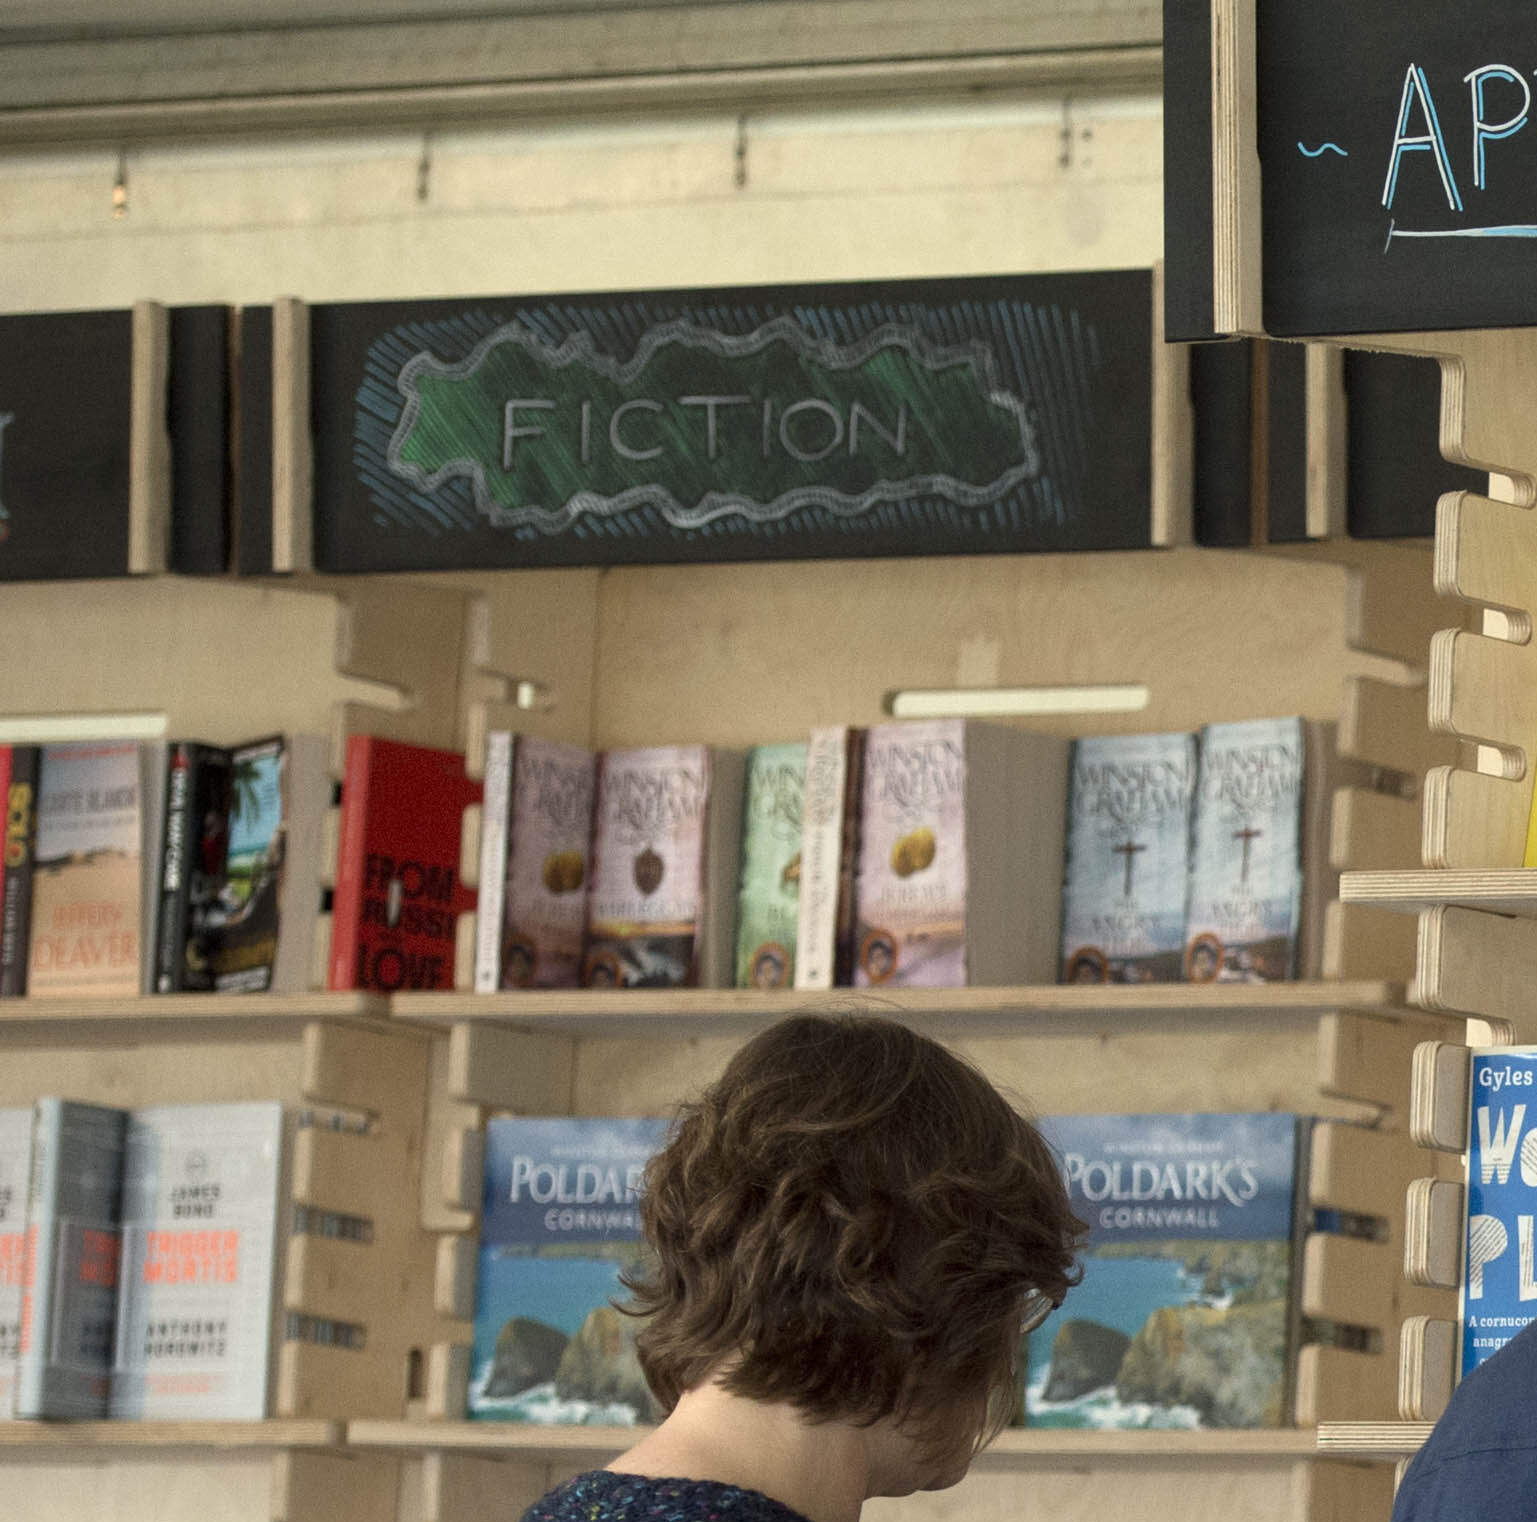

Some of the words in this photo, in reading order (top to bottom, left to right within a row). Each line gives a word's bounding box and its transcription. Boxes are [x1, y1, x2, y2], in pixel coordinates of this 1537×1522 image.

[502, 393, 907, 471] FICTION
[1479, 1067, 1533, 1091] Gyles
[1064, 1151, 1260, 1208] POLDARK'S
[1099, 1206, 1221, 1230] CORNWALL
[1469, 1315, 1478, 1328] A
